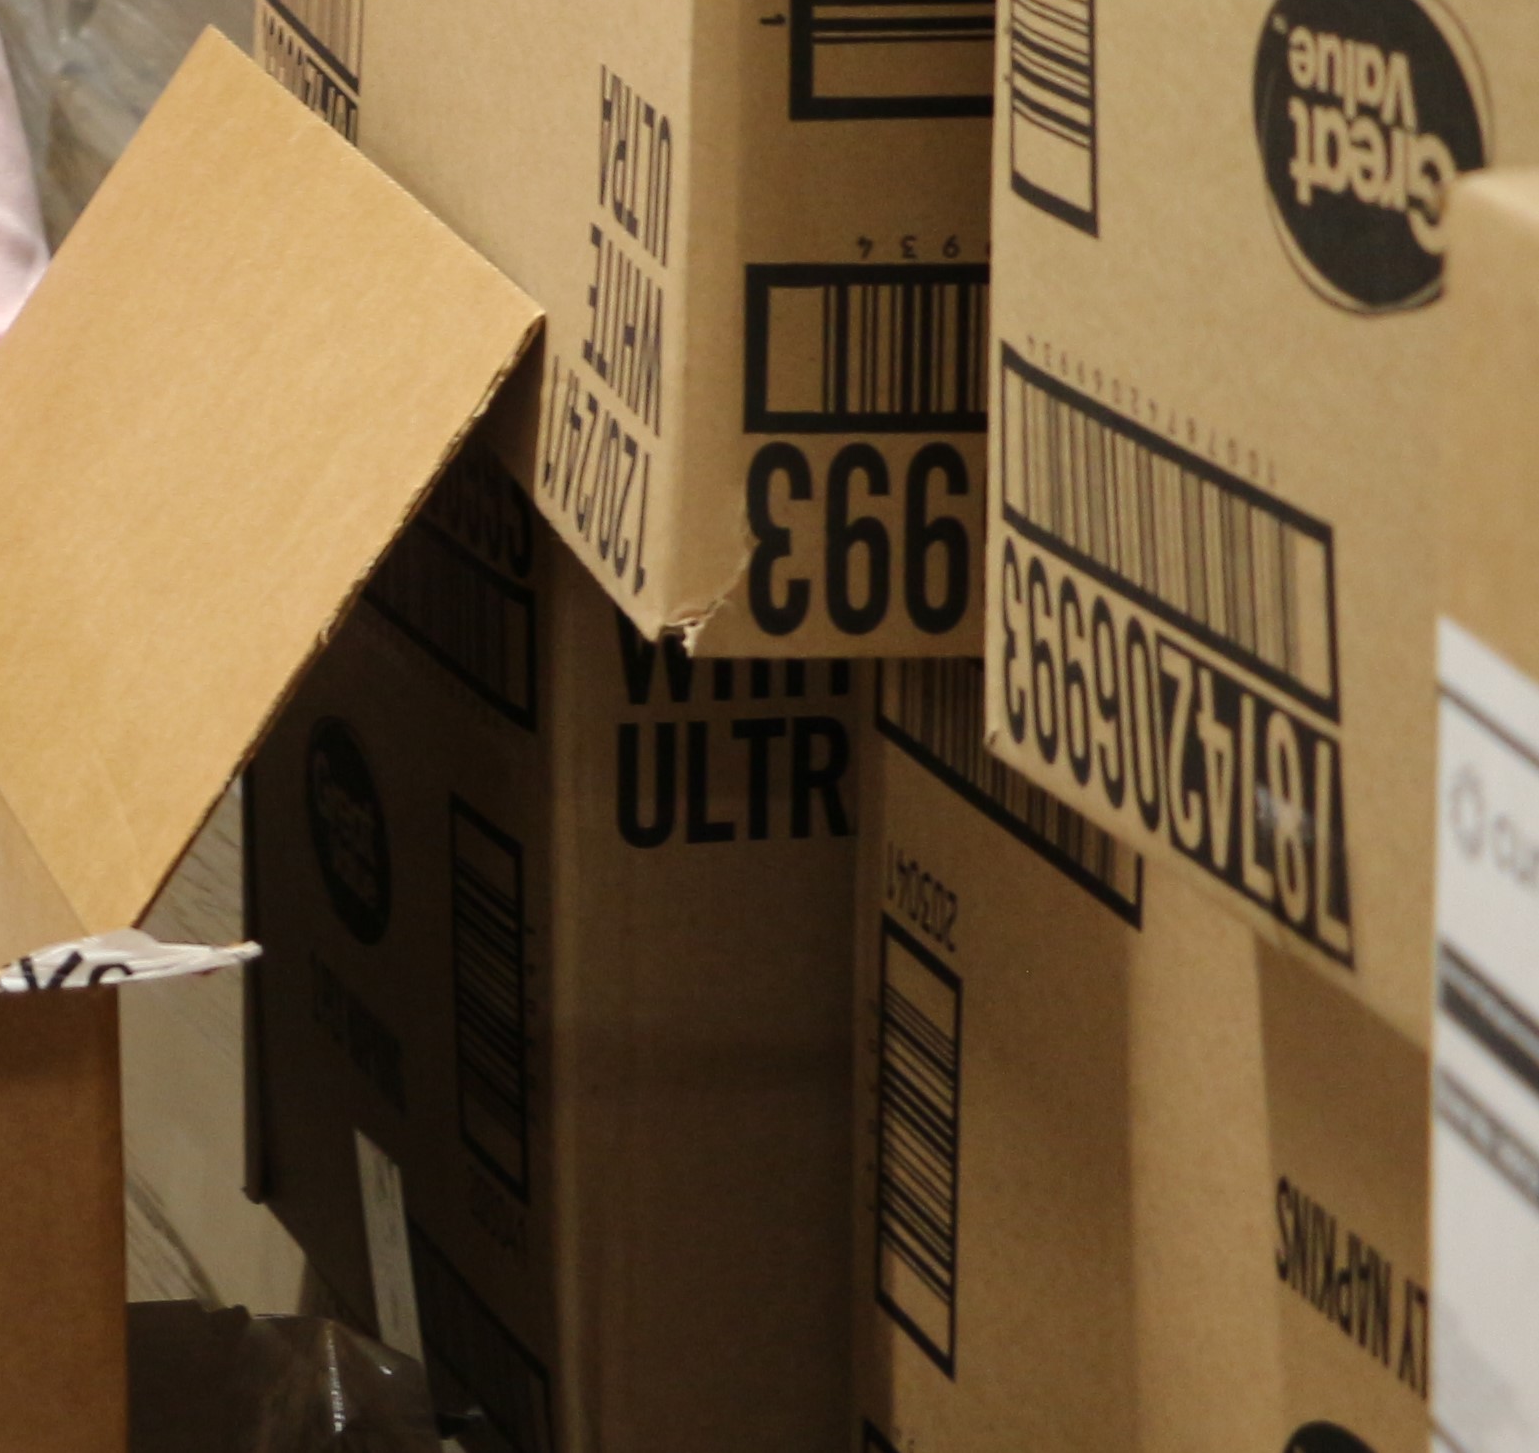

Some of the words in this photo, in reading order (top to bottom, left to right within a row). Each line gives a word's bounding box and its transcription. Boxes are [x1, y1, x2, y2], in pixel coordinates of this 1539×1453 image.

[1286, 25, 1417, 131] Value
[598, 65, 672, 269] ULTRA
[1287, 96, 1456, 257] Great
[581, 222, 663, 440] WHITE
[616, 715, 856, 850] ULTR
[1275, 1176, 1392, 1369] NAPKINS
